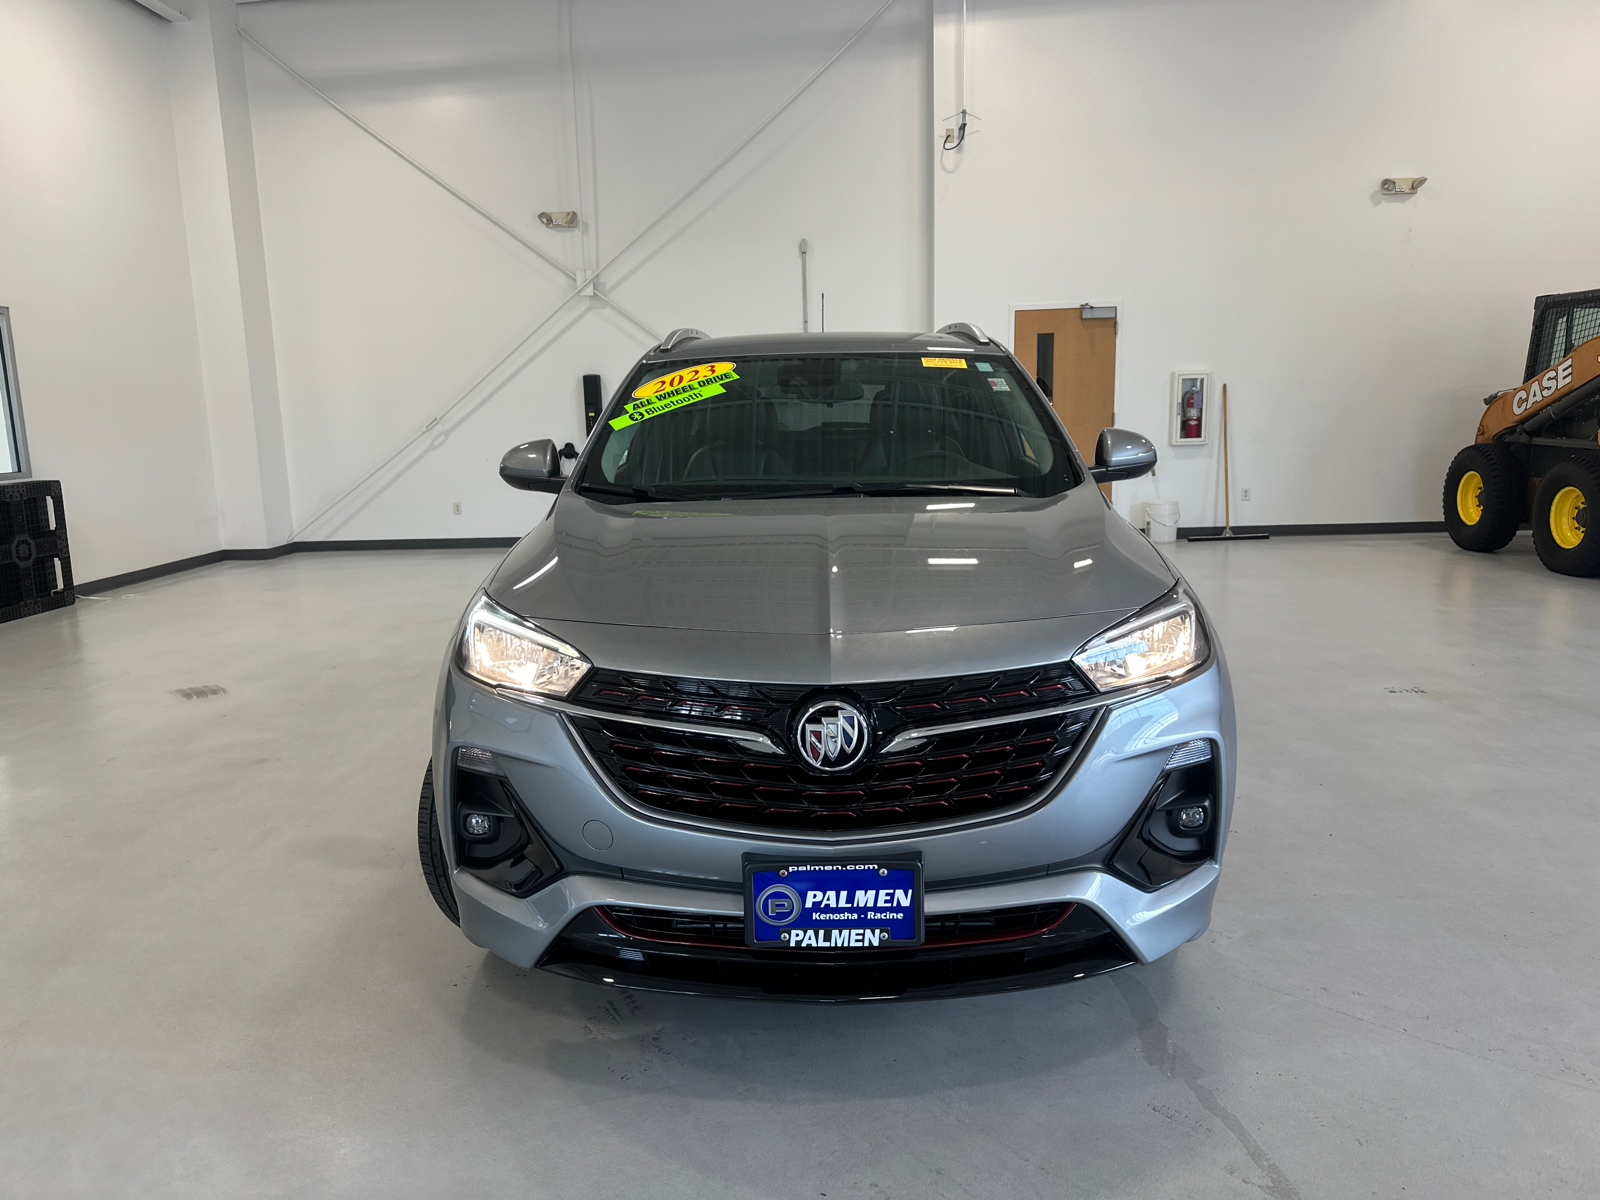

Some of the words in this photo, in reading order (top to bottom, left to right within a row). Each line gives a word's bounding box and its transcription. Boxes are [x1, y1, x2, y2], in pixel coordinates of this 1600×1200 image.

[653, 365, 716, 394] 2023
[1512, 357, 1572, 416] CASE
[632, 398, 655, 411] ALL
[656, 383, 697, 401] WHEEL
[644, 391, 703, 416] Bluetooth
[788, 864, 878, 872] palmen.com
[804, 889, 913, 909] PALMEN
[812, 912, 858, 920] Kenosha
[867, 911, 904, 920] Racine
[789, 929, 881, 947] PALMEN
